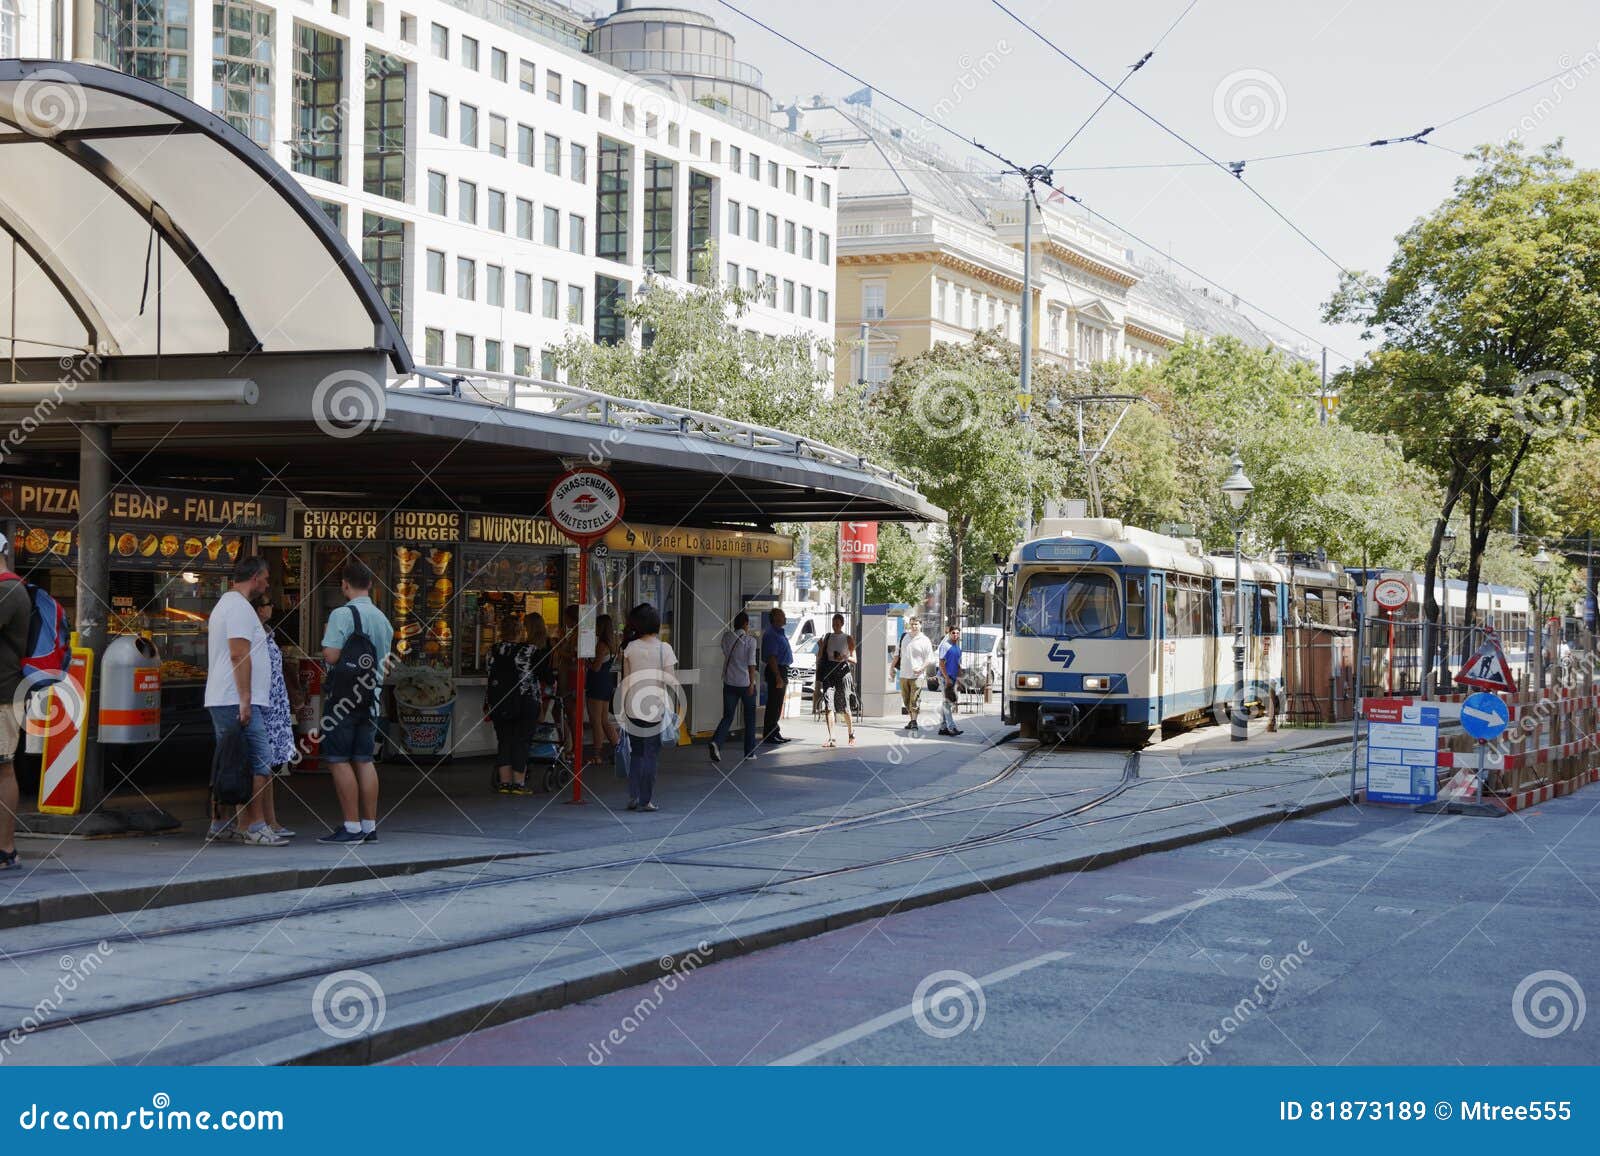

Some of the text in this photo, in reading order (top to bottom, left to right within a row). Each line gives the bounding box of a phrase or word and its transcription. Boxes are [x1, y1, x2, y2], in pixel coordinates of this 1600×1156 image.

[556, 476, 616, 500] STRASSENBAHN
[20, 485, 80, 515] PIZZA
[303, 511, 377, 526] CEVAPCICI
[394, 511, 460, 527] HOTDOG
[557, 510, 613, 530] HALTESTELLE
[303, 525, 377, 539] BURGER
[393, 526, 460, 541] BURGER
[641, 530, 769, 554] Wiener Lokalbahnen AG
[595, 546, 608, 557] 62
